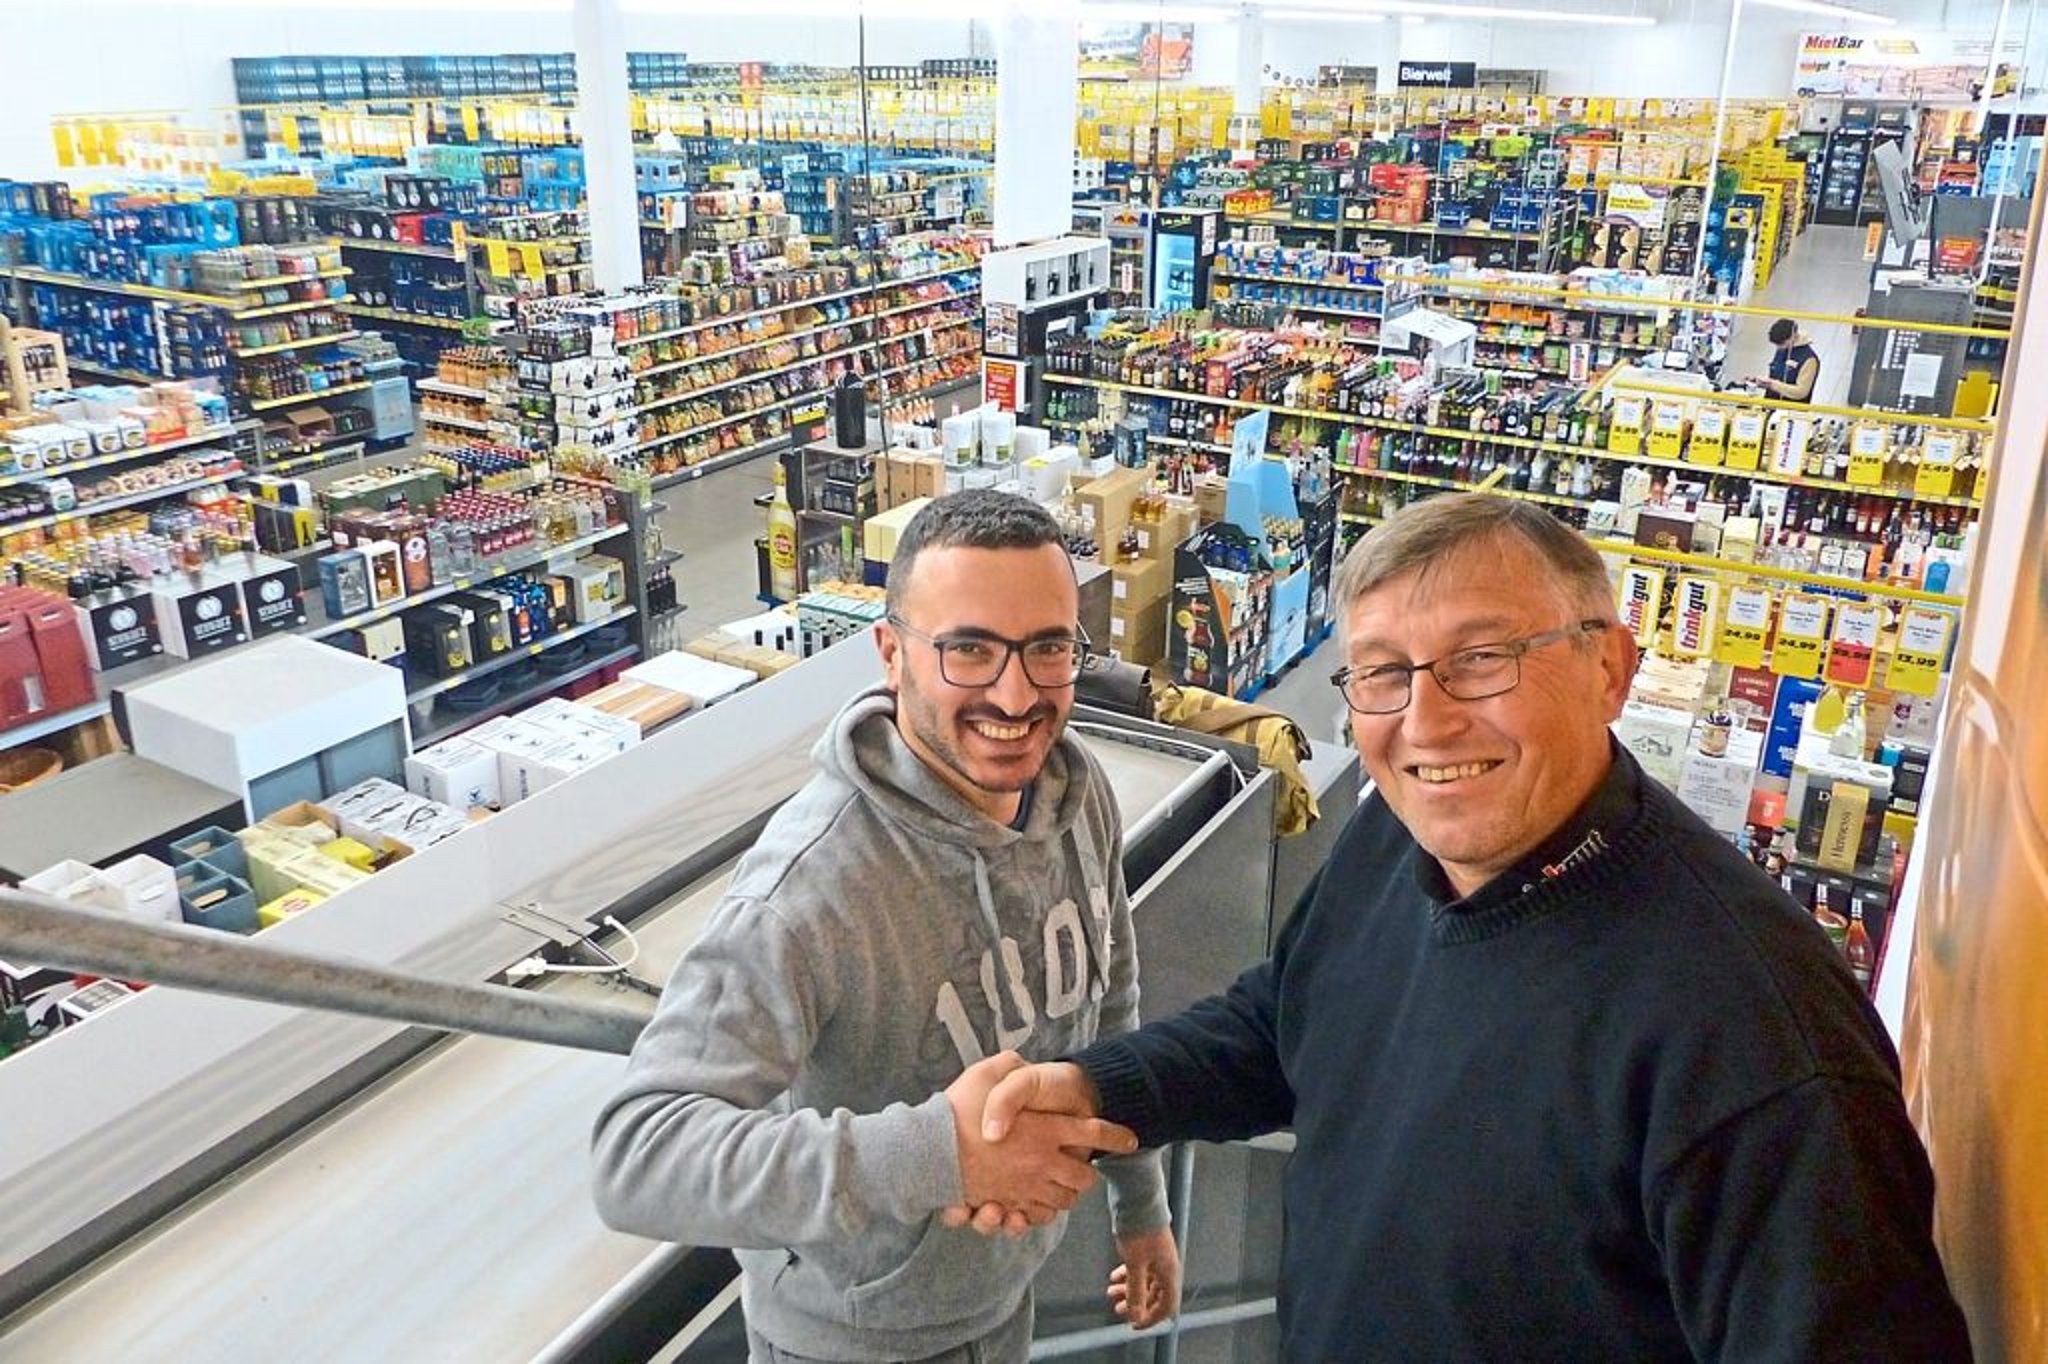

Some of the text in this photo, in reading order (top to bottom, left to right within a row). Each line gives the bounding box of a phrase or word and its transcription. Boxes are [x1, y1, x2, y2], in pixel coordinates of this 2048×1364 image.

[1805, 36, 1864, 49] MietBar
[1401, 66, 1453, 81] Bierwelt
[1626, 573, 1650, 635] rinkgut
[1680, 581, 1709, 650] trinkgut
